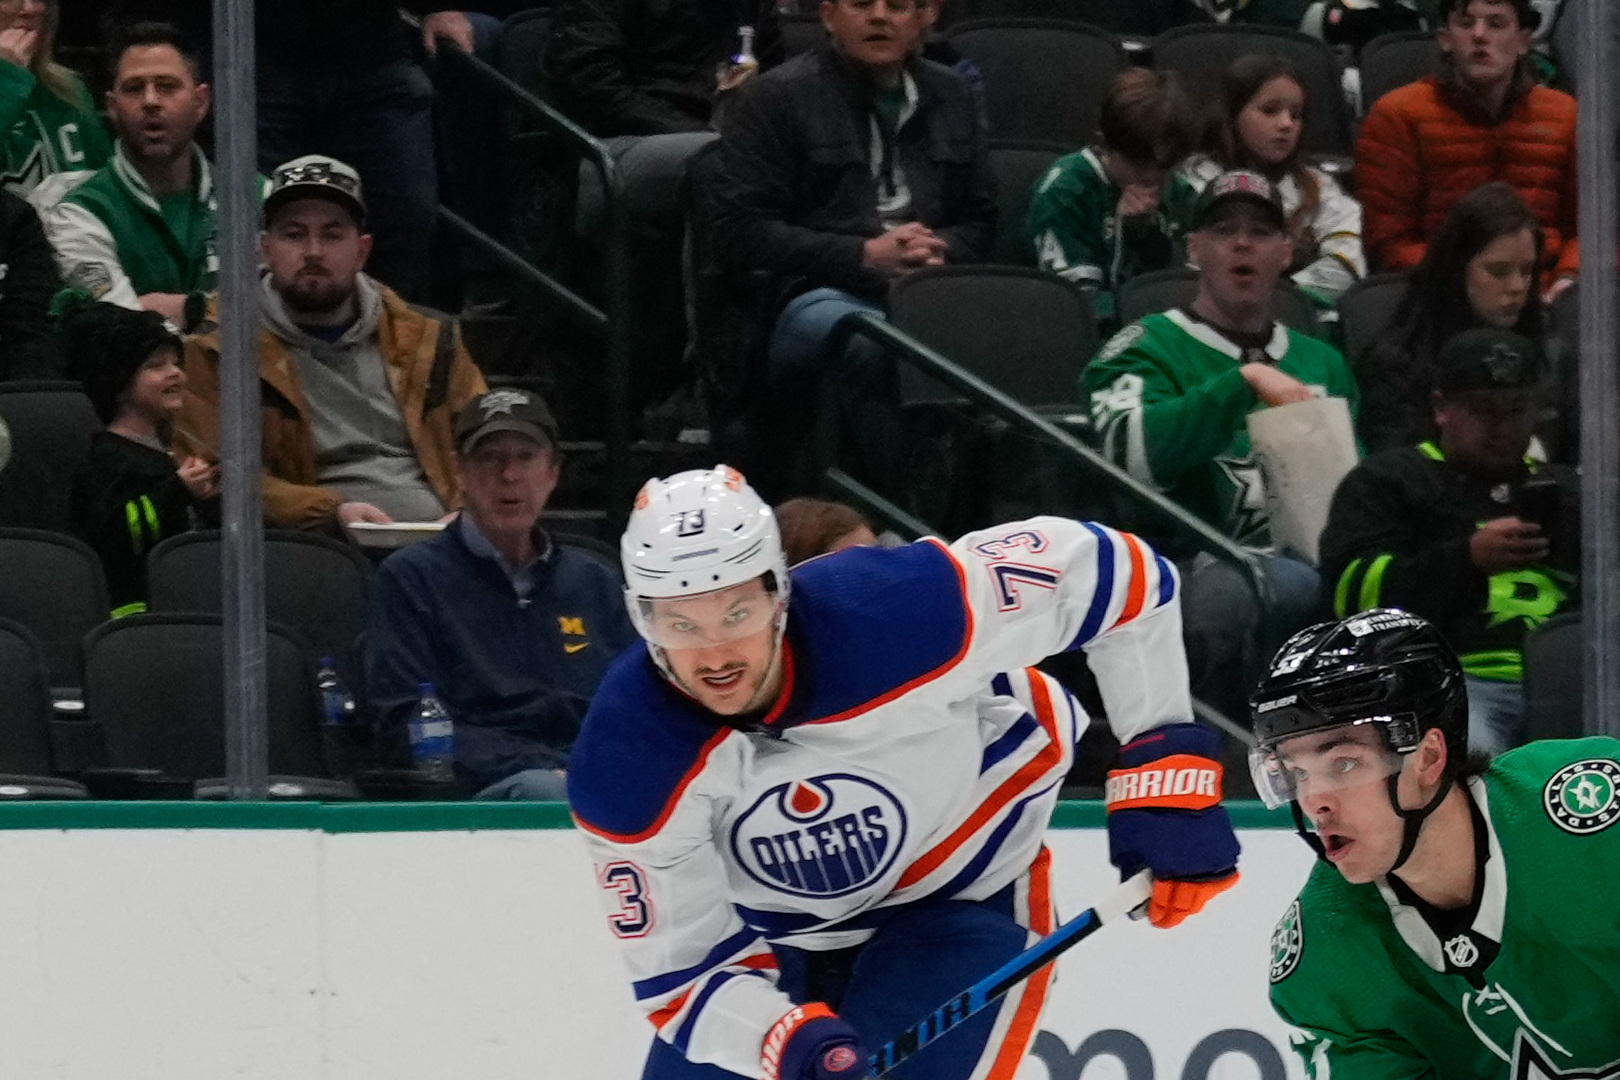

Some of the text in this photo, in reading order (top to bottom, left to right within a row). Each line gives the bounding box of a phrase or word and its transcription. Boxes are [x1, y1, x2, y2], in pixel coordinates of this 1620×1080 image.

[967, 529, 1062, 613] 73
[1105, 768, 1217, 804] ARRIOR
[750, 804, 890, 893] OILERS
[593, 860, 656, 940] 3
